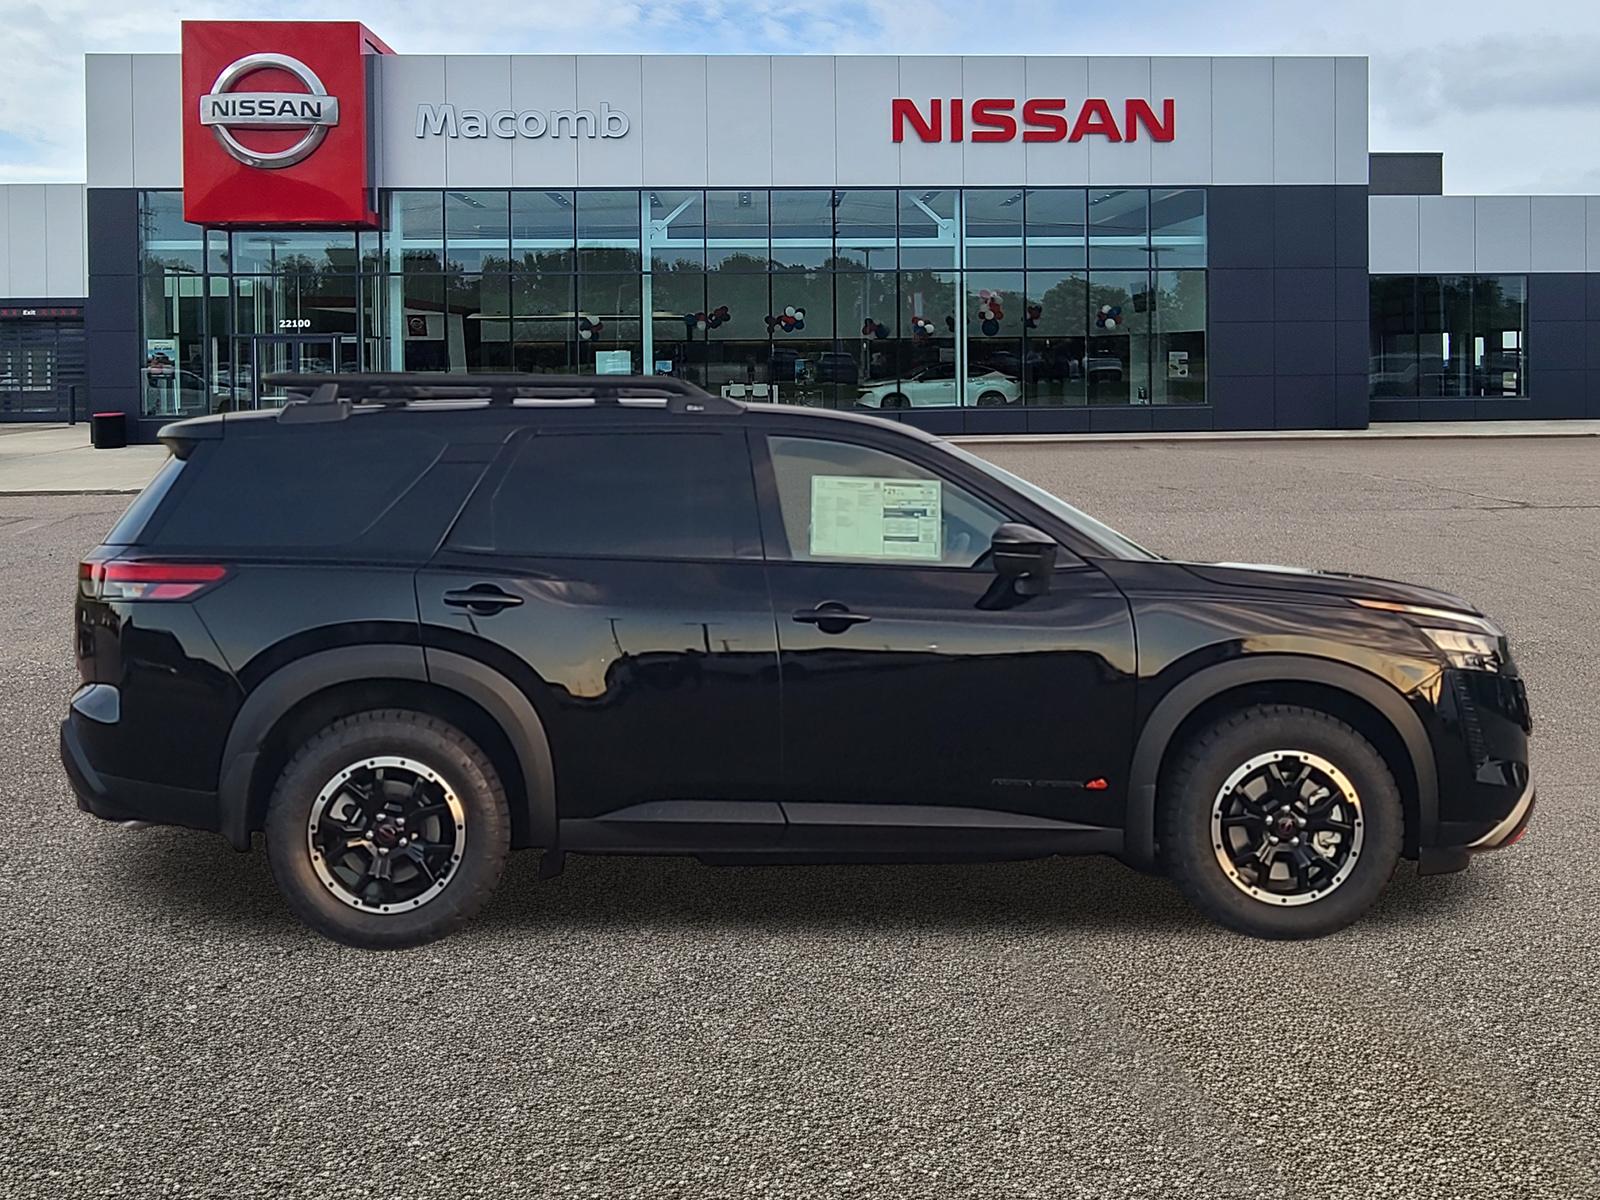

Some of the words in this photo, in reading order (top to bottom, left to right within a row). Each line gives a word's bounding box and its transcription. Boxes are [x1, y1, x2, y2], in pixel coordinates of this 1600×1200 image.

[212, 100, 321, 117] NISSAN
[415, 102, 630, 138] Macomb
[892, 98, 1175, 143] NISSAN
[279, 319, 311, 328] 22100
